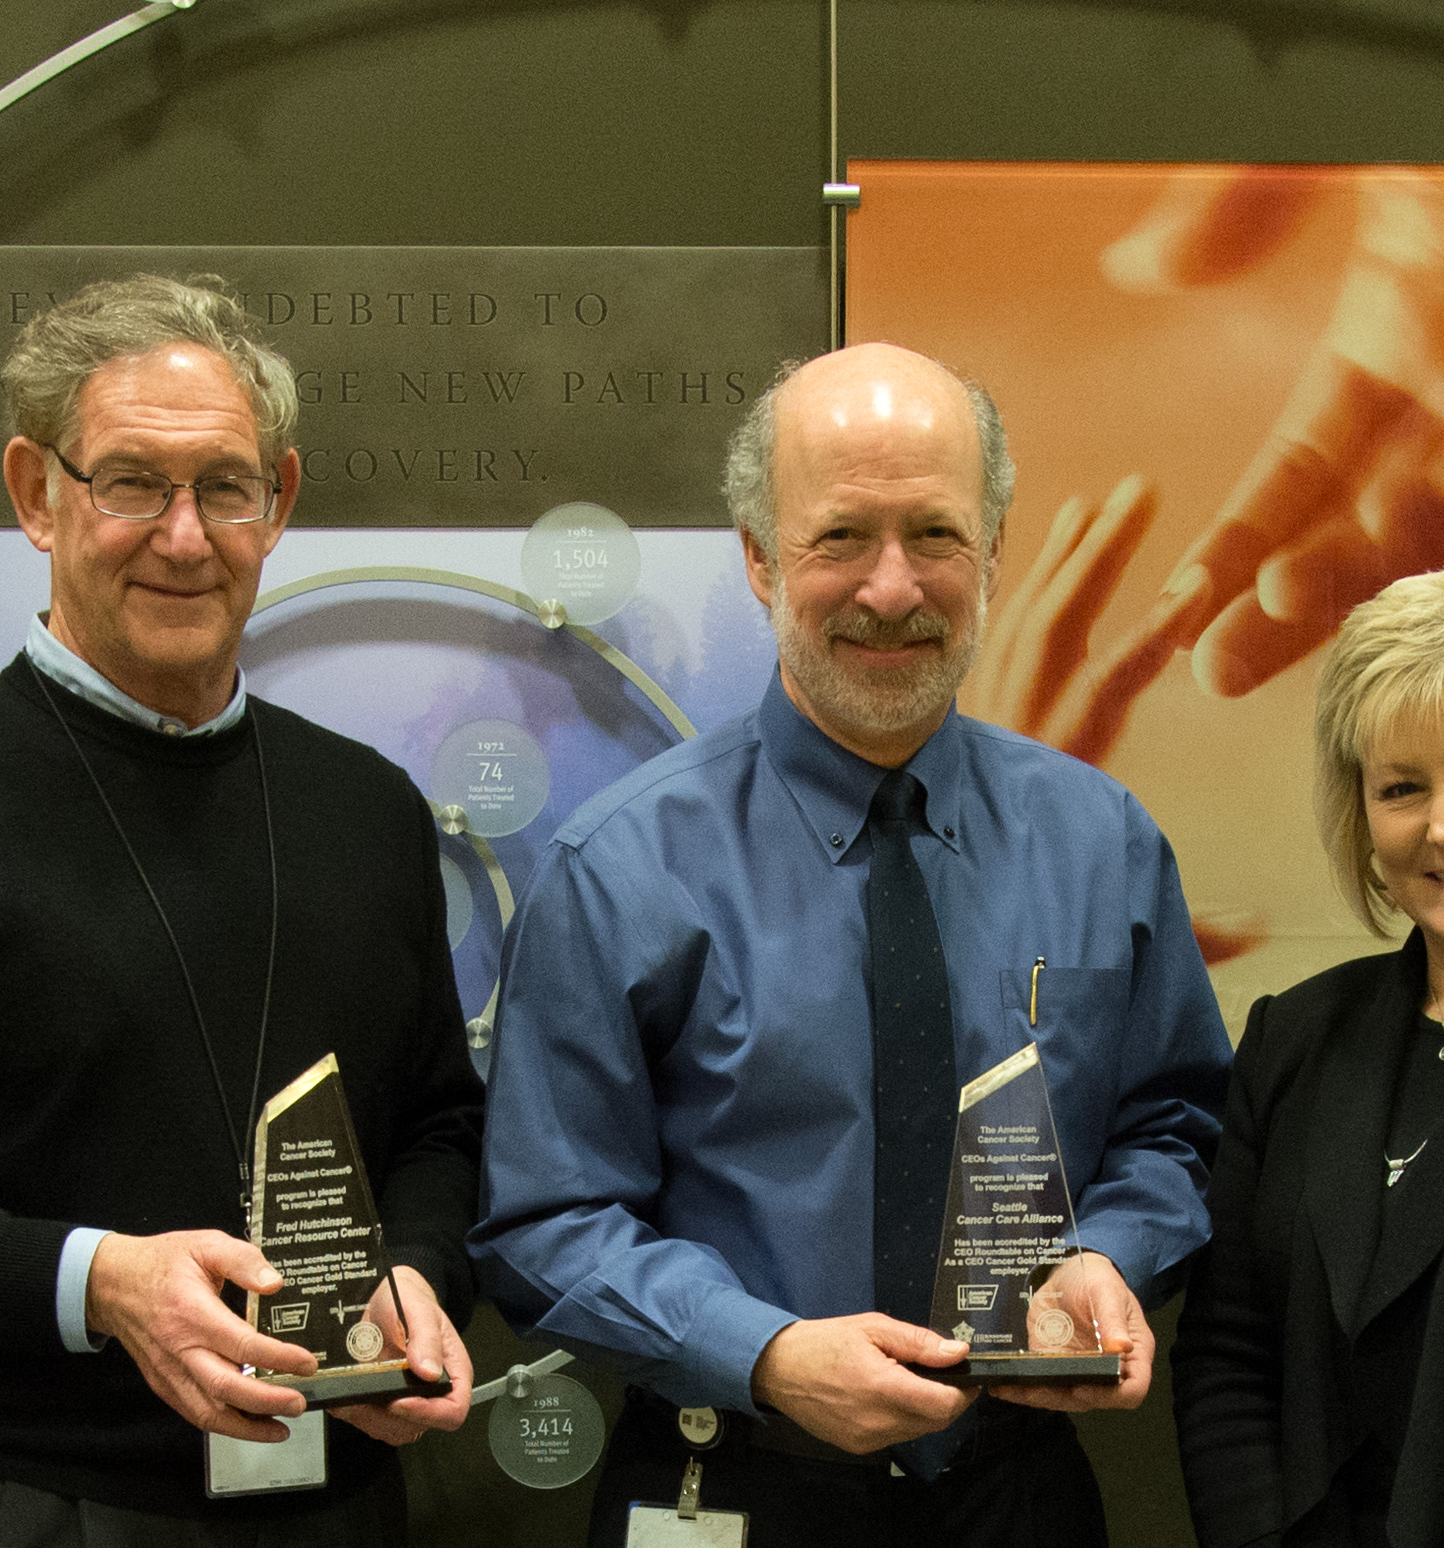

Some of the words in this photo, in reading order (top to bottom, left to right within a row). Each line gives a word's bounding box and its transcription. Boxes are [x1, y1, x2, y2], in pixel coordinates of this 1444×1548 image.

[241, 292, 498, 327] DEBTED
[534, 292, 610, 327] TO
[398, 371, 527, 405] NEW
[561, 371, 747, 405] PATHS
[301, 448, 549, 484] COVERY.
[566, 526, 595, 540] 1982
[553, 549, 609, 571] 1,504
[477, 742, 505, 754] 1972
[479, 762, 503, 781] 74
[980, 1125, 996, 1134] The
[997, 1124, 1037, 1134] American
[297, 1139, 333, 1150] American
[977, 1135, 1008, 1144] Cancer
[1008, 1134, 1040, 1145] Society
[279, 1151, 307, 1161] Cancer
[307, 1148, 336, 1159] Society
[961, 1154, 985, 1163] CEOs
[986, 1154, 1019, 1164] Against
[267, 1172, 289, 1182] CEOs
[290, 1169, 320, 1181] Against
[969, 1173, 1005, 1184] program
[1015, 1172, 1049, 1183] pleased
[275, 1190, 308, 1203] program
[317, 1185, 347, 1198] pleased
[974, 1184, 984, 1192] to
[985, 1183, 1026, 1193] recognize
[1027, 1182, 1044, 1191] that
[281, 1203, 290, 1211] to
[290, 1198, 327, 1210] recognize
[328, 1196, 344, 1206] that
[991, 1202, 1028, 1213] Seattle
[275, 1220, 299, 1233] Fred
[298, 1216, 353, 1231] Hutchinson
[956, 1214, 994, 1225] Cancer
[995, 1214, 1020, 1224] Care
[1021, 1213, 1064, 1224] Alliance
[261, 1235, 293, 1247] Cancer
[294, 1230, 339, 1243] Resource
[340, 1226, 372, 1238] Center
[954, 1238, 971, 1247] Has
[972, 1238, 993, 1247] been
[994, 1236, 1038, 1246] accredited
[1039, 1236, 1051, 1247] by
[342, 1251, 354, 1261] by
[953, 1247, 972, 1257] CEO
[974, 1247, 1022, 1256] Roundtable
[341, 1260, 368, 1270] Cancer
[944, 1257, 957, 1267] As
[964, 1257, 984, 1266] CEO
[985, 1256, 1015, 1266] Cancer
[1016, 1256, 1037, 1265] Gold
[284, 1277, 296, 1287] EO
[296, 1274, 324, 1286] Cancer
[324, 1272, 343, 1282] Gold
[343, 1267, 378, 1280] Standard
[533, 1396, 560, 1409] 1988
[519, 1417, 574, 1439] 3,414
